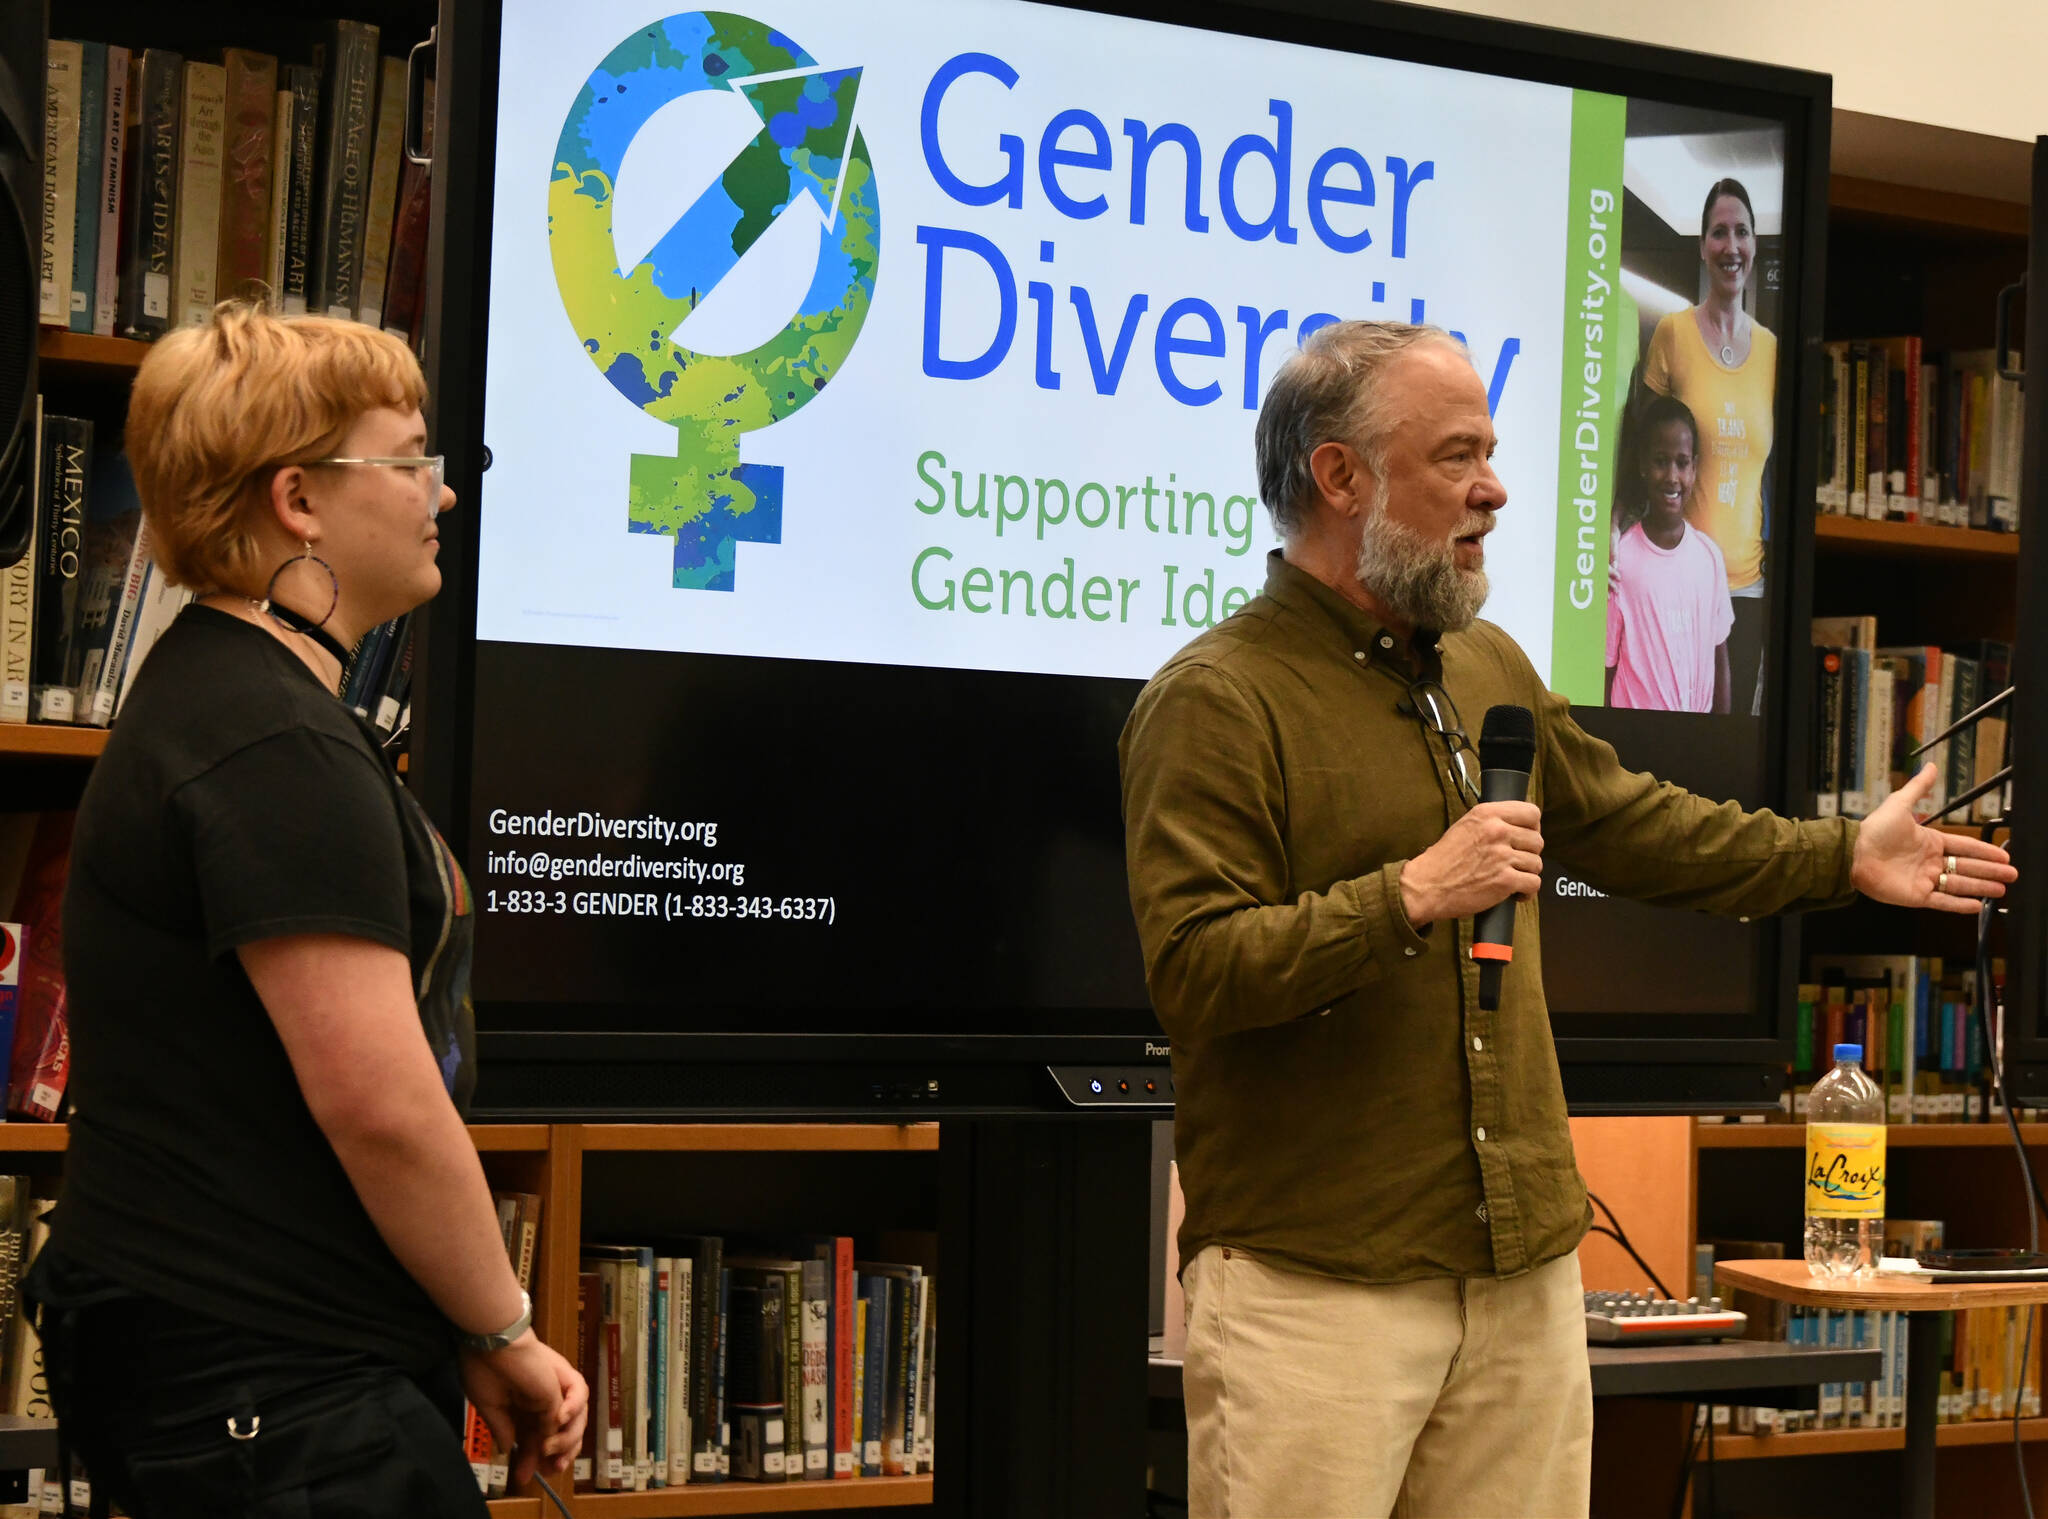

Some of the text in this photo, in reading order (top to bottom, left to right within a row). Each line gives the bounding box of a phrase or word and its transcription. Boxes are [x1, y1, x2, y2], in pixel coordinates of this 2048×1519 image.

[107, 87, 122, 214] THE ART OF FEMINISM
[155, 115, 172, 175] ARTS
[920, 52, 1434, 259] Gender
[41, 85, 59, 283] AMERICAN INDIAN ART
[344, 163, 360, 189] OF
[151, 202, 169, 273] IDEAS
[289, 256, 306, 294] ART
[916, 225, 1520, 420] Divery
[1568, 188, 1614, 610] GenderDiversity.org
[60, 444, 86, 579] MEXICO
[914, 450, 1257, 556] Supporting
[127, 574, 143, 601] BIG
[911, 546, 1264, 629] Gender Ide
[8, 616, 28, 645] IN
[116, 606, 132, 640] David
[103, 639, 124, 689] Macaulay
[489, 808, 718, 848] GenderDiversity.org
[487, 850, 745, 886] info@genderdiversity.org
[487, 889, 836, 925] 1-833-3 GENDER (1-833-343-6337)
[1808, 1152, 1881, 1194] LaCroix
